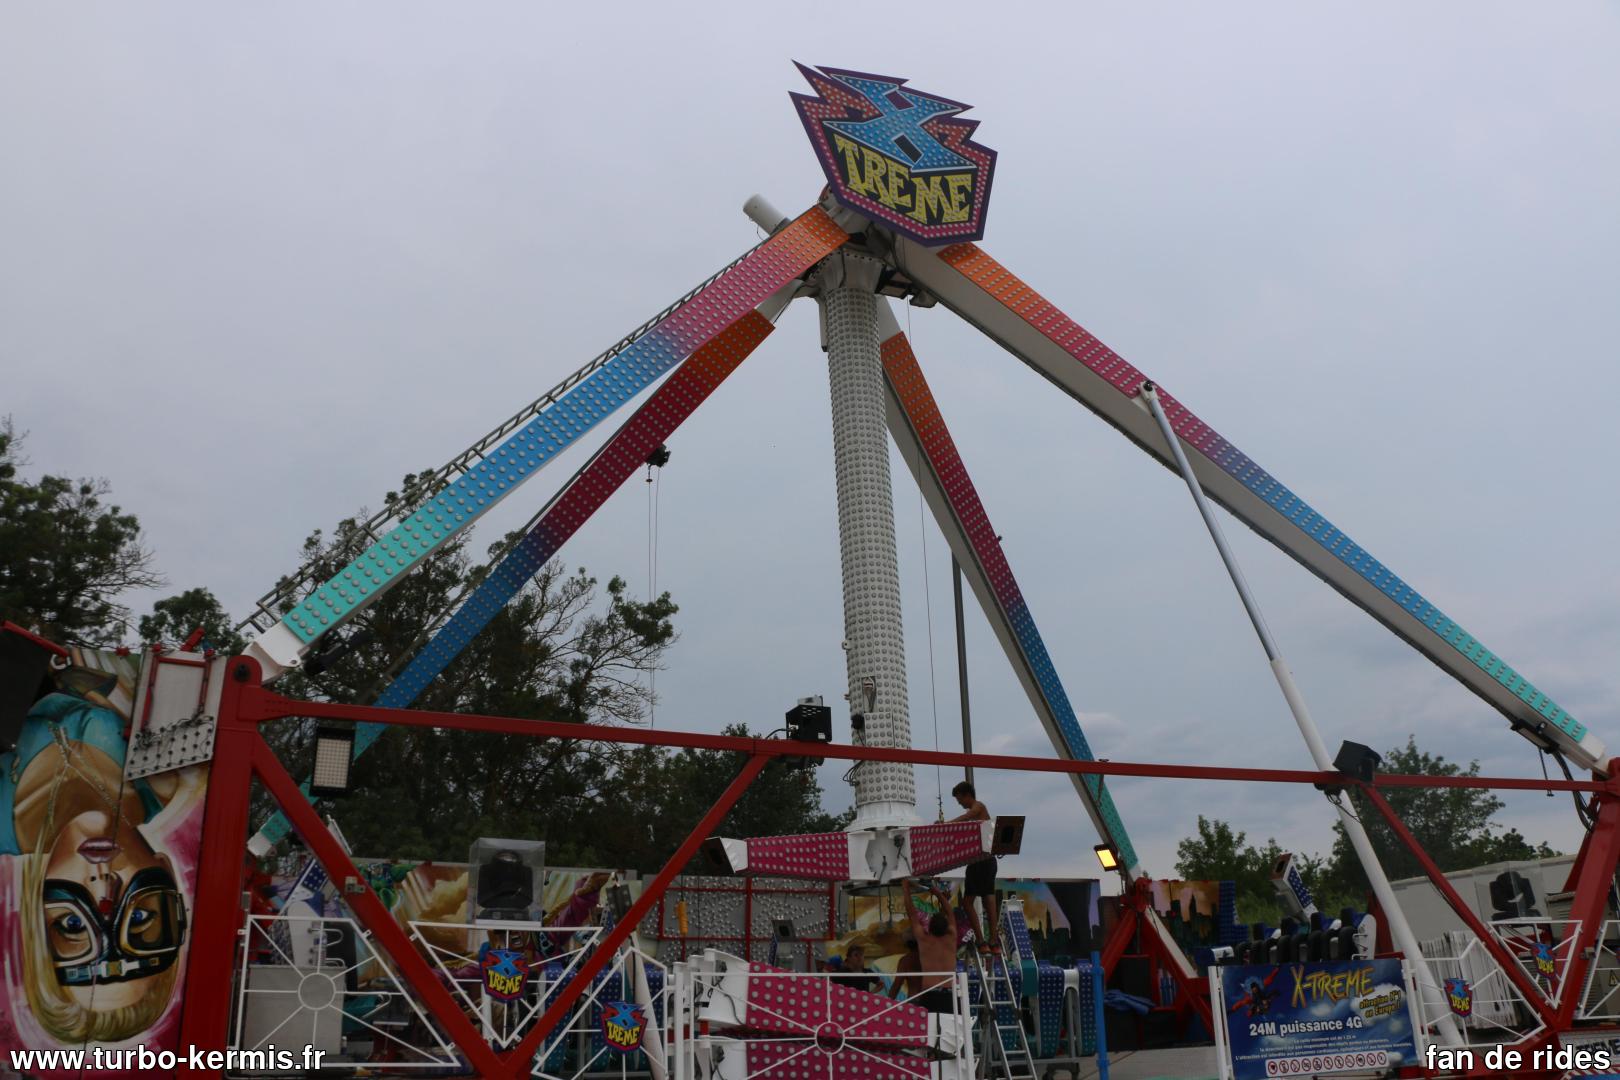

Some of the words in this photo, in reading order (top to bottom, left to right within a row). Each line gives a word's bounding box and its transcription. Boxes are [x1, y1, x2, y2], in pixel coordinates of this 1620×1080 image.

[822, 73, 978, 172] X
[833, 133, 973, 225] TREME
[486, 949, 524, 978] X
[487, 969, 523, 995] TREME
[1290, 964, 1376, 1008] X-TREME
[606, 1001, 643, 1030] X
[1249, 1021, 1277, 1037] 24M
[1279, 1018, 1343, 1037] puissance
[1346, 1015, 1363, 1030] 4G
[606, 1021, 641, 1046] TREME
